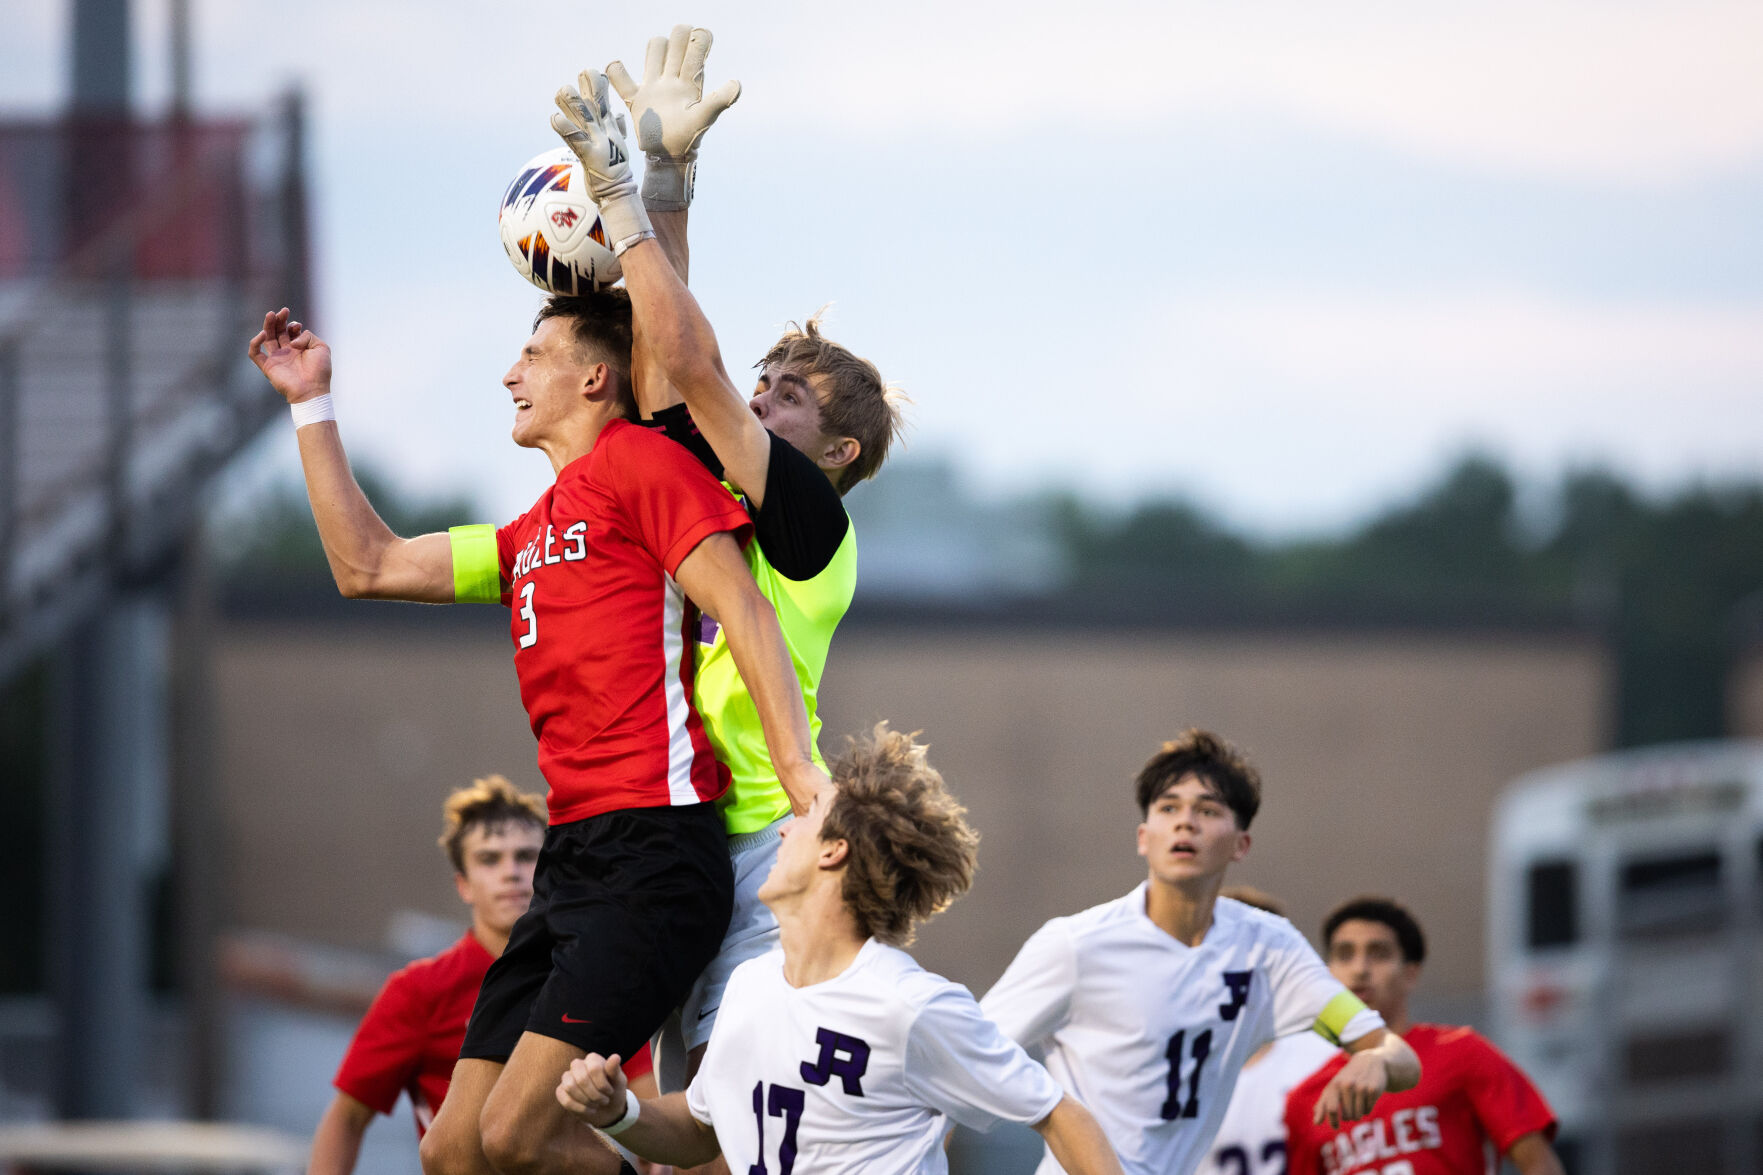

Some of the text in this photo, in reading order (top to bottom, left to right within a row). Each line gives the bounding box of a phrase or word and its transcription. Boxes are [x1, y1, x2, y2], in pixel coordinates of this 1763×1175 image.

[511, 519, 589, 589] AGLES
[518, 580, 538, 650] 3
[799, 1026, 872, 1098] JR
[1160, 1028, 1213, 1122] 11
[748, 1080, 806, 1175] 17
